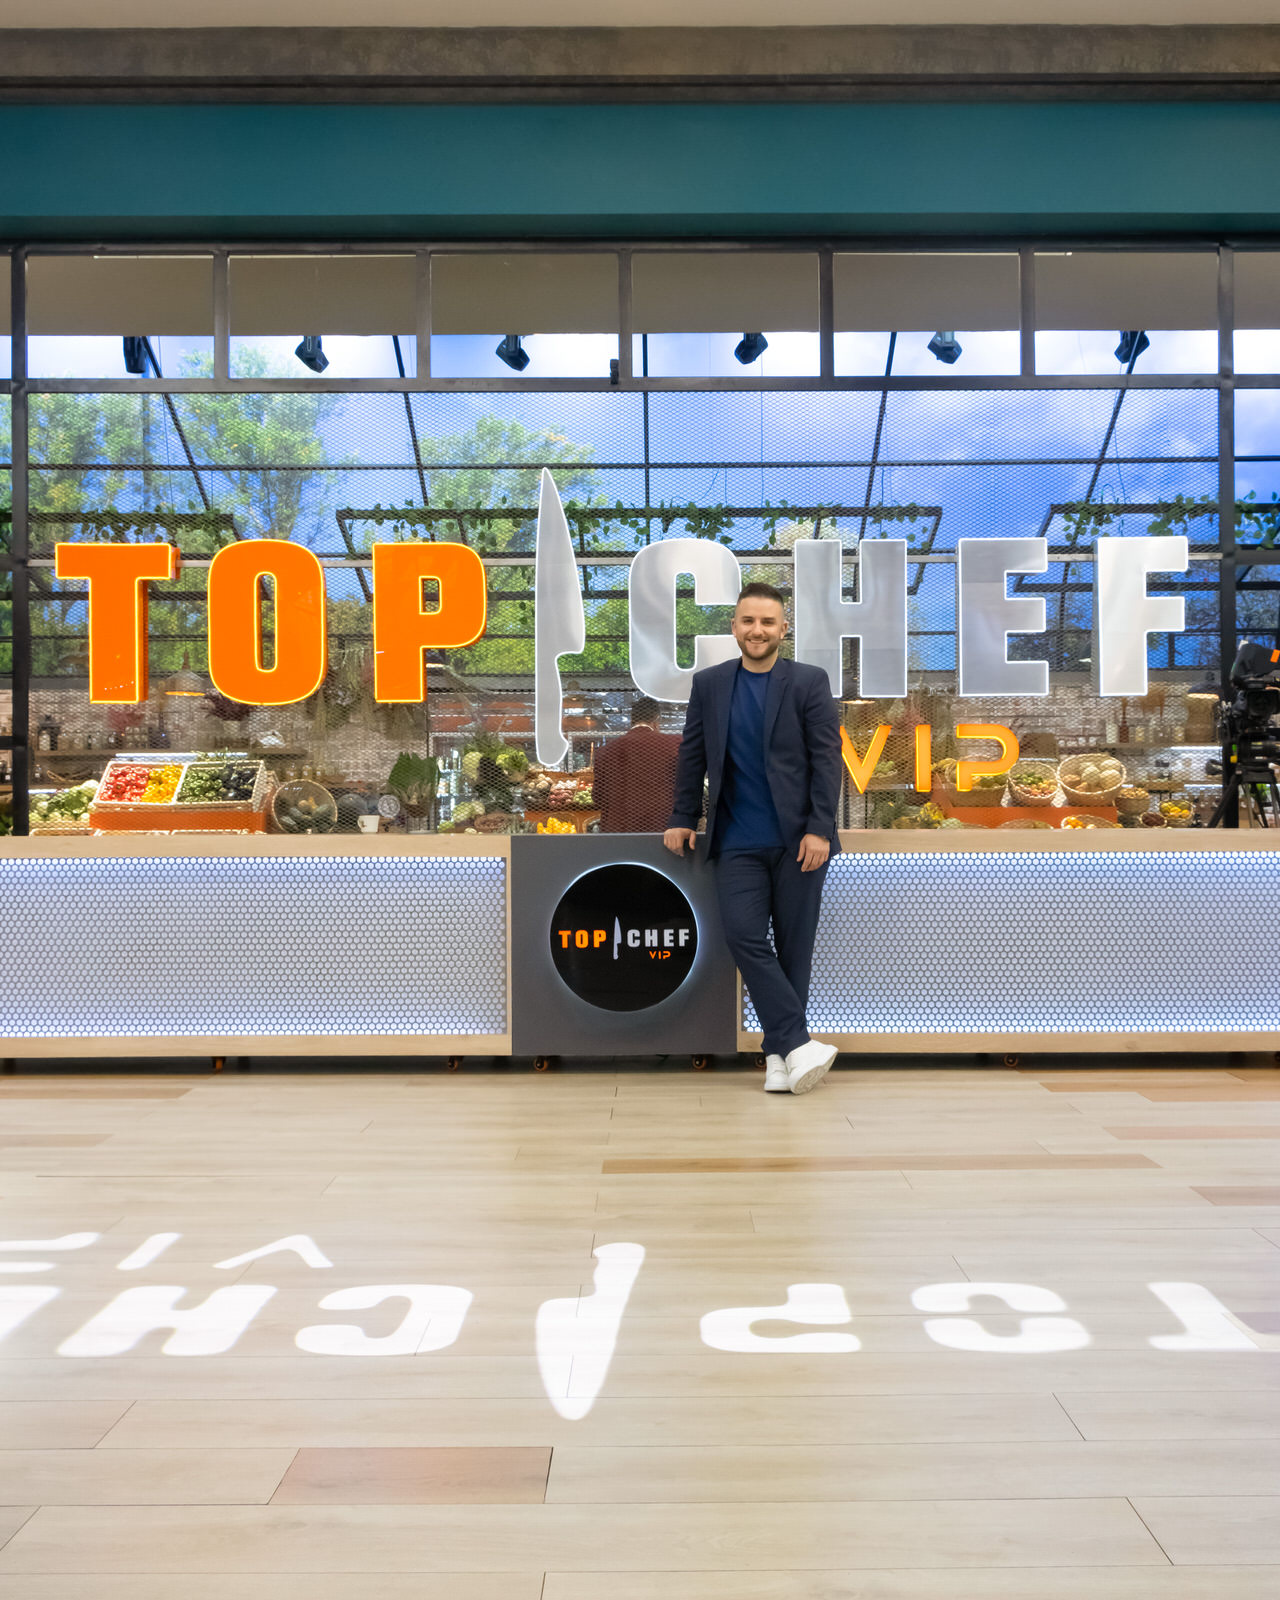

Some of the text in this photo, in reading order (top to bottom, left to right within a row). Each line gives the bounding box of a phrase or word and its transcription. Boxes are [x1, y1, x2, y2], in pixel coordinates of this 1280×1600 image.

[55, 535, 1190, 706] TOP CHEF
[840, 723, 1020, 795] VIP
[558, 928, 690, 949] TOP CHEF
[649, 950, 671, 960] VIP
[0, 1283, 475, 1357] CH
